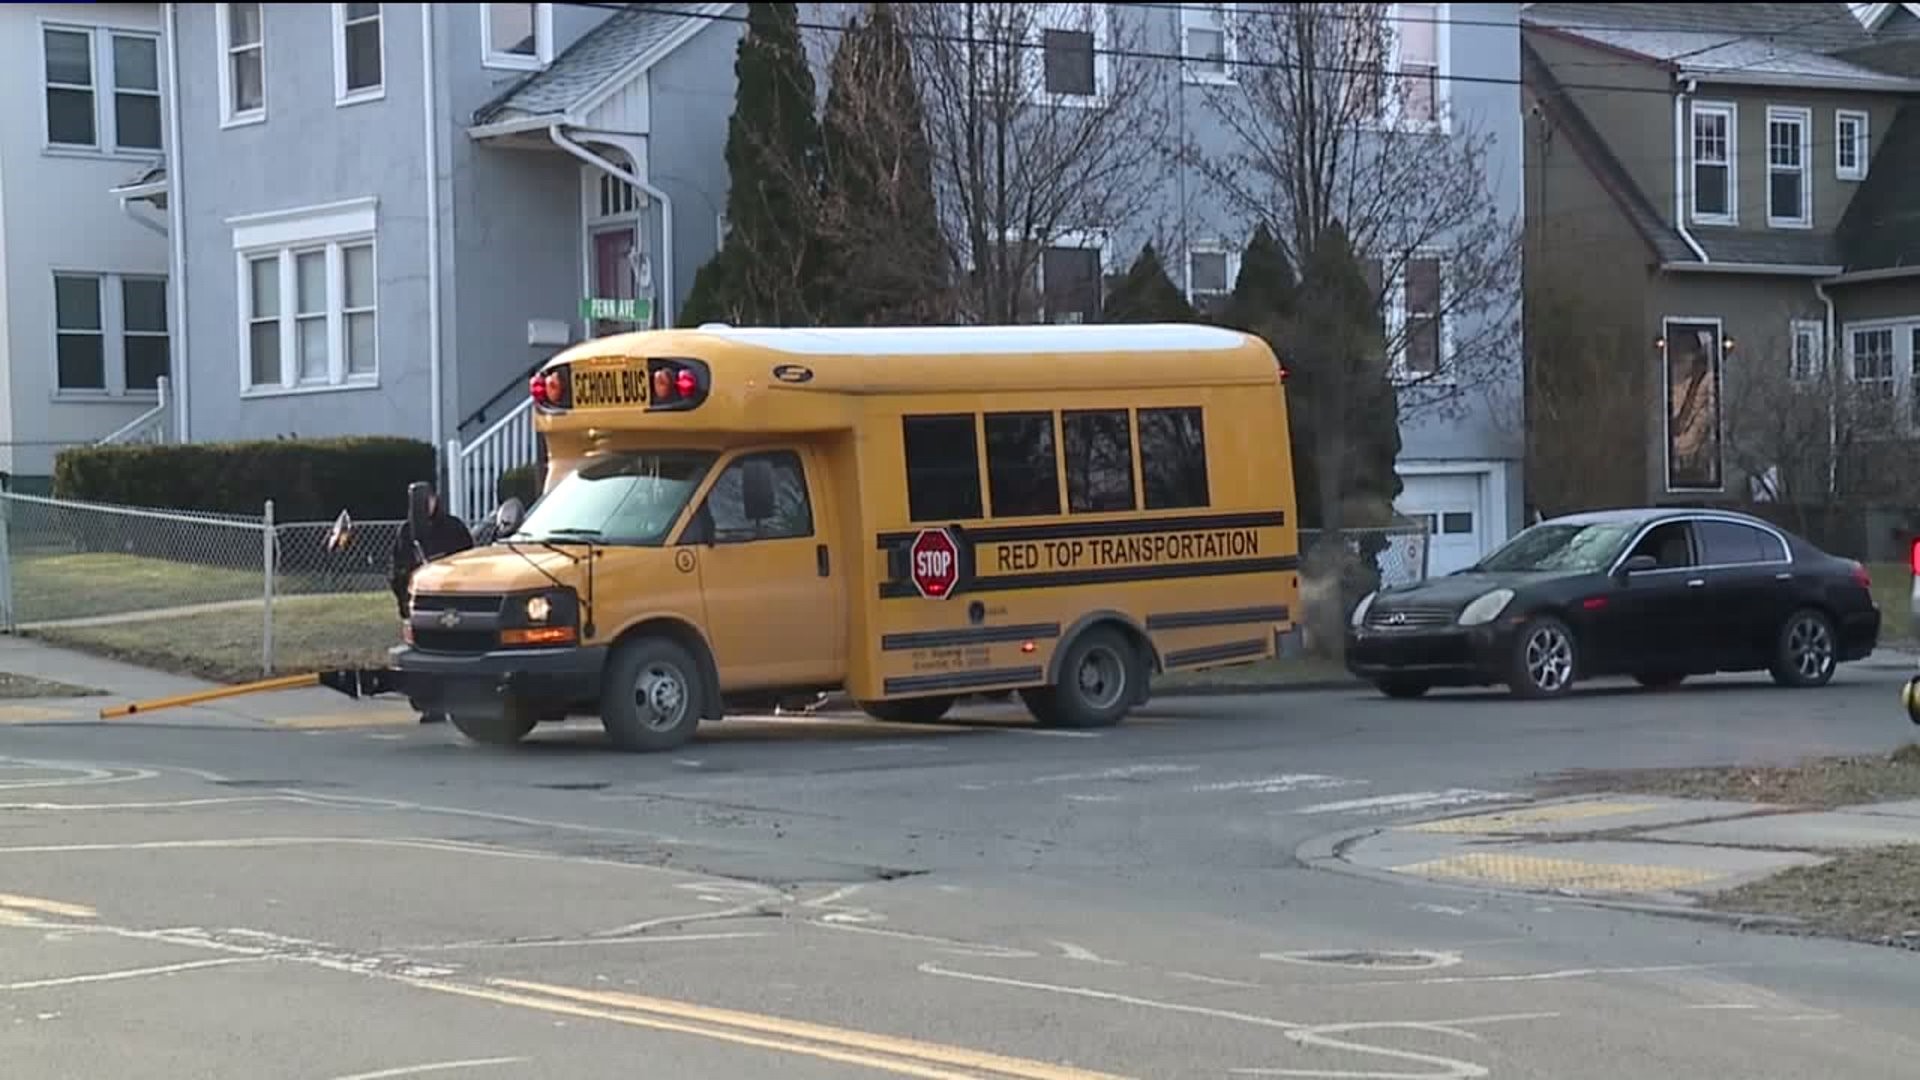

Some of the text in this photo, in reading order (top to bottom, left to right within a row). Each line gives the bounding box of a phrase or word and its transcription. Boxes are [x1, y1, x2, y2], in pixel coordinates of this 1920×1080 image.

[591, 299, 634, 318] PENN AVE
[575, 369, 647, 404] SCHOOL BUS
[917, 551, 951, 576] STOP
[998, 530, 1259, 570] RED TOP TRANSPORTATION
